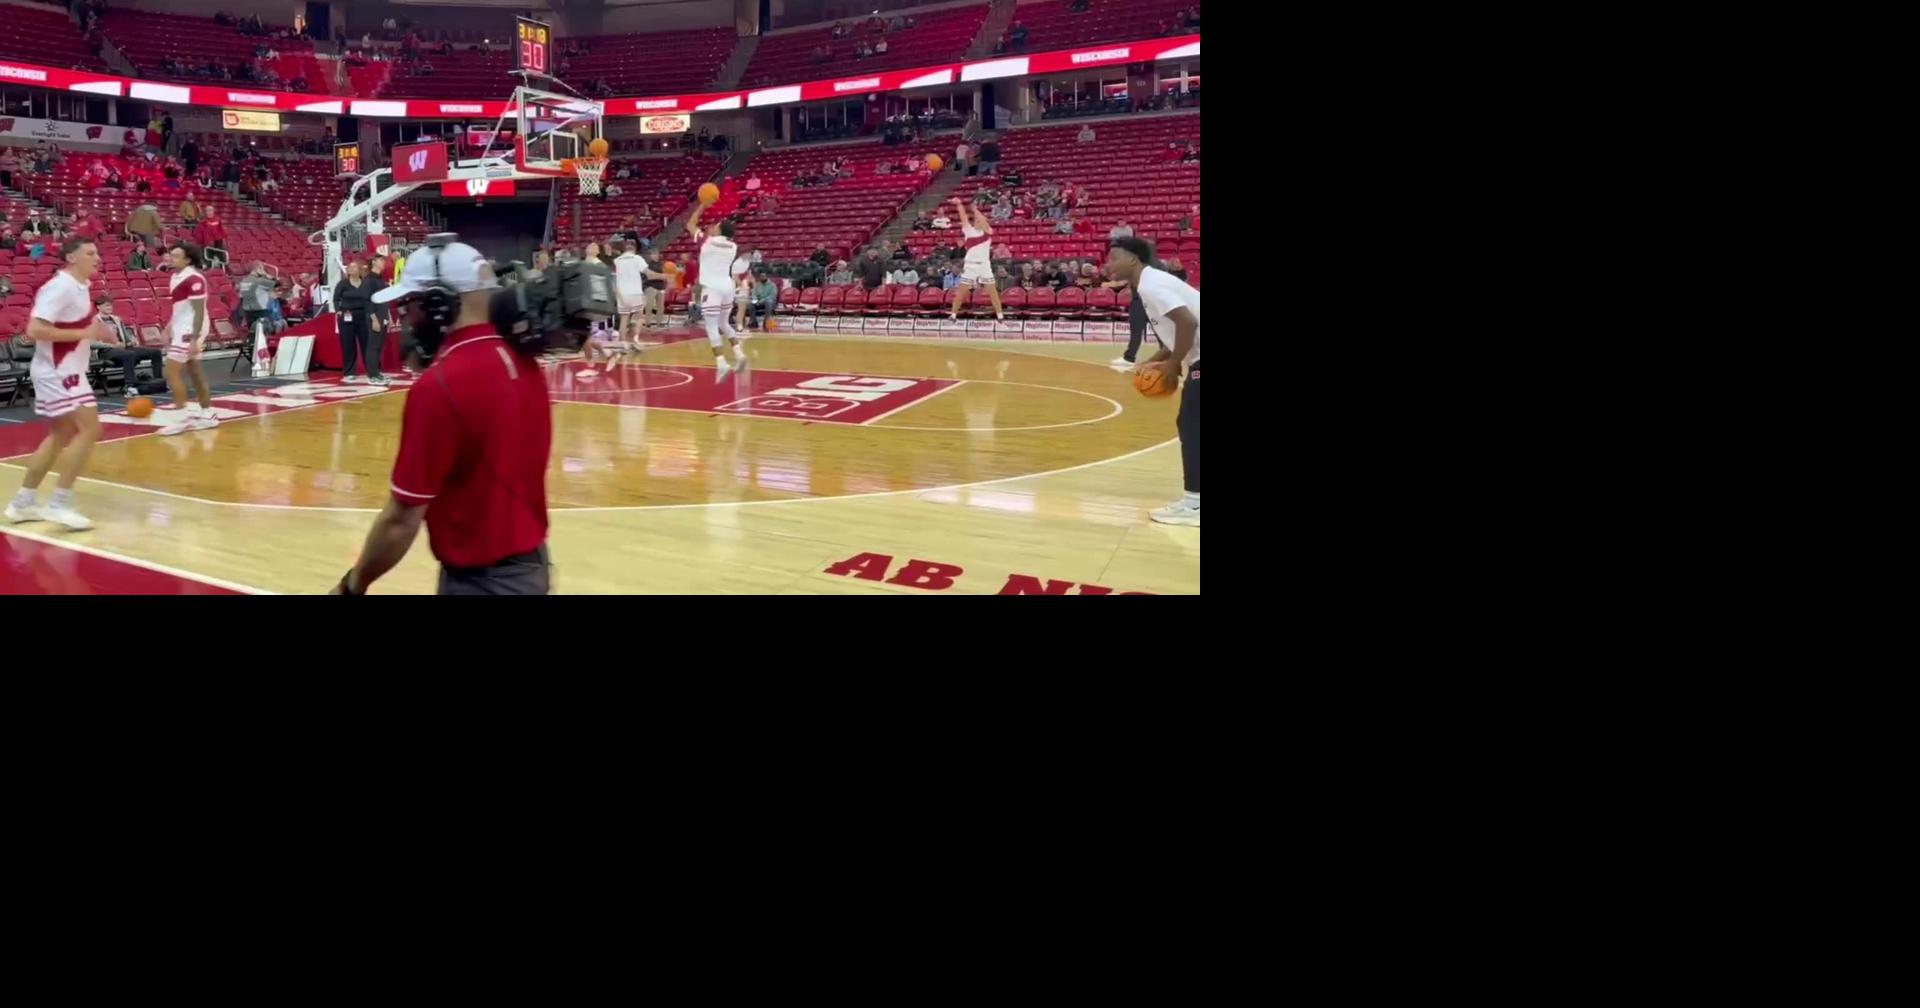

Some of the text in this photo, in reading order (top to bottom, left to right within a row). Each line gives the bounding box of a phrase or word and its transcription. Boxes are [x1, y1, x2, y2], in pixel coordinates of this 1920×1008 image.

[521, 41, 543, 69] 30
[342, 158, 356, 171] 30
[408, 150, 427, 172] W
[823, 552, 963, 590] AB
